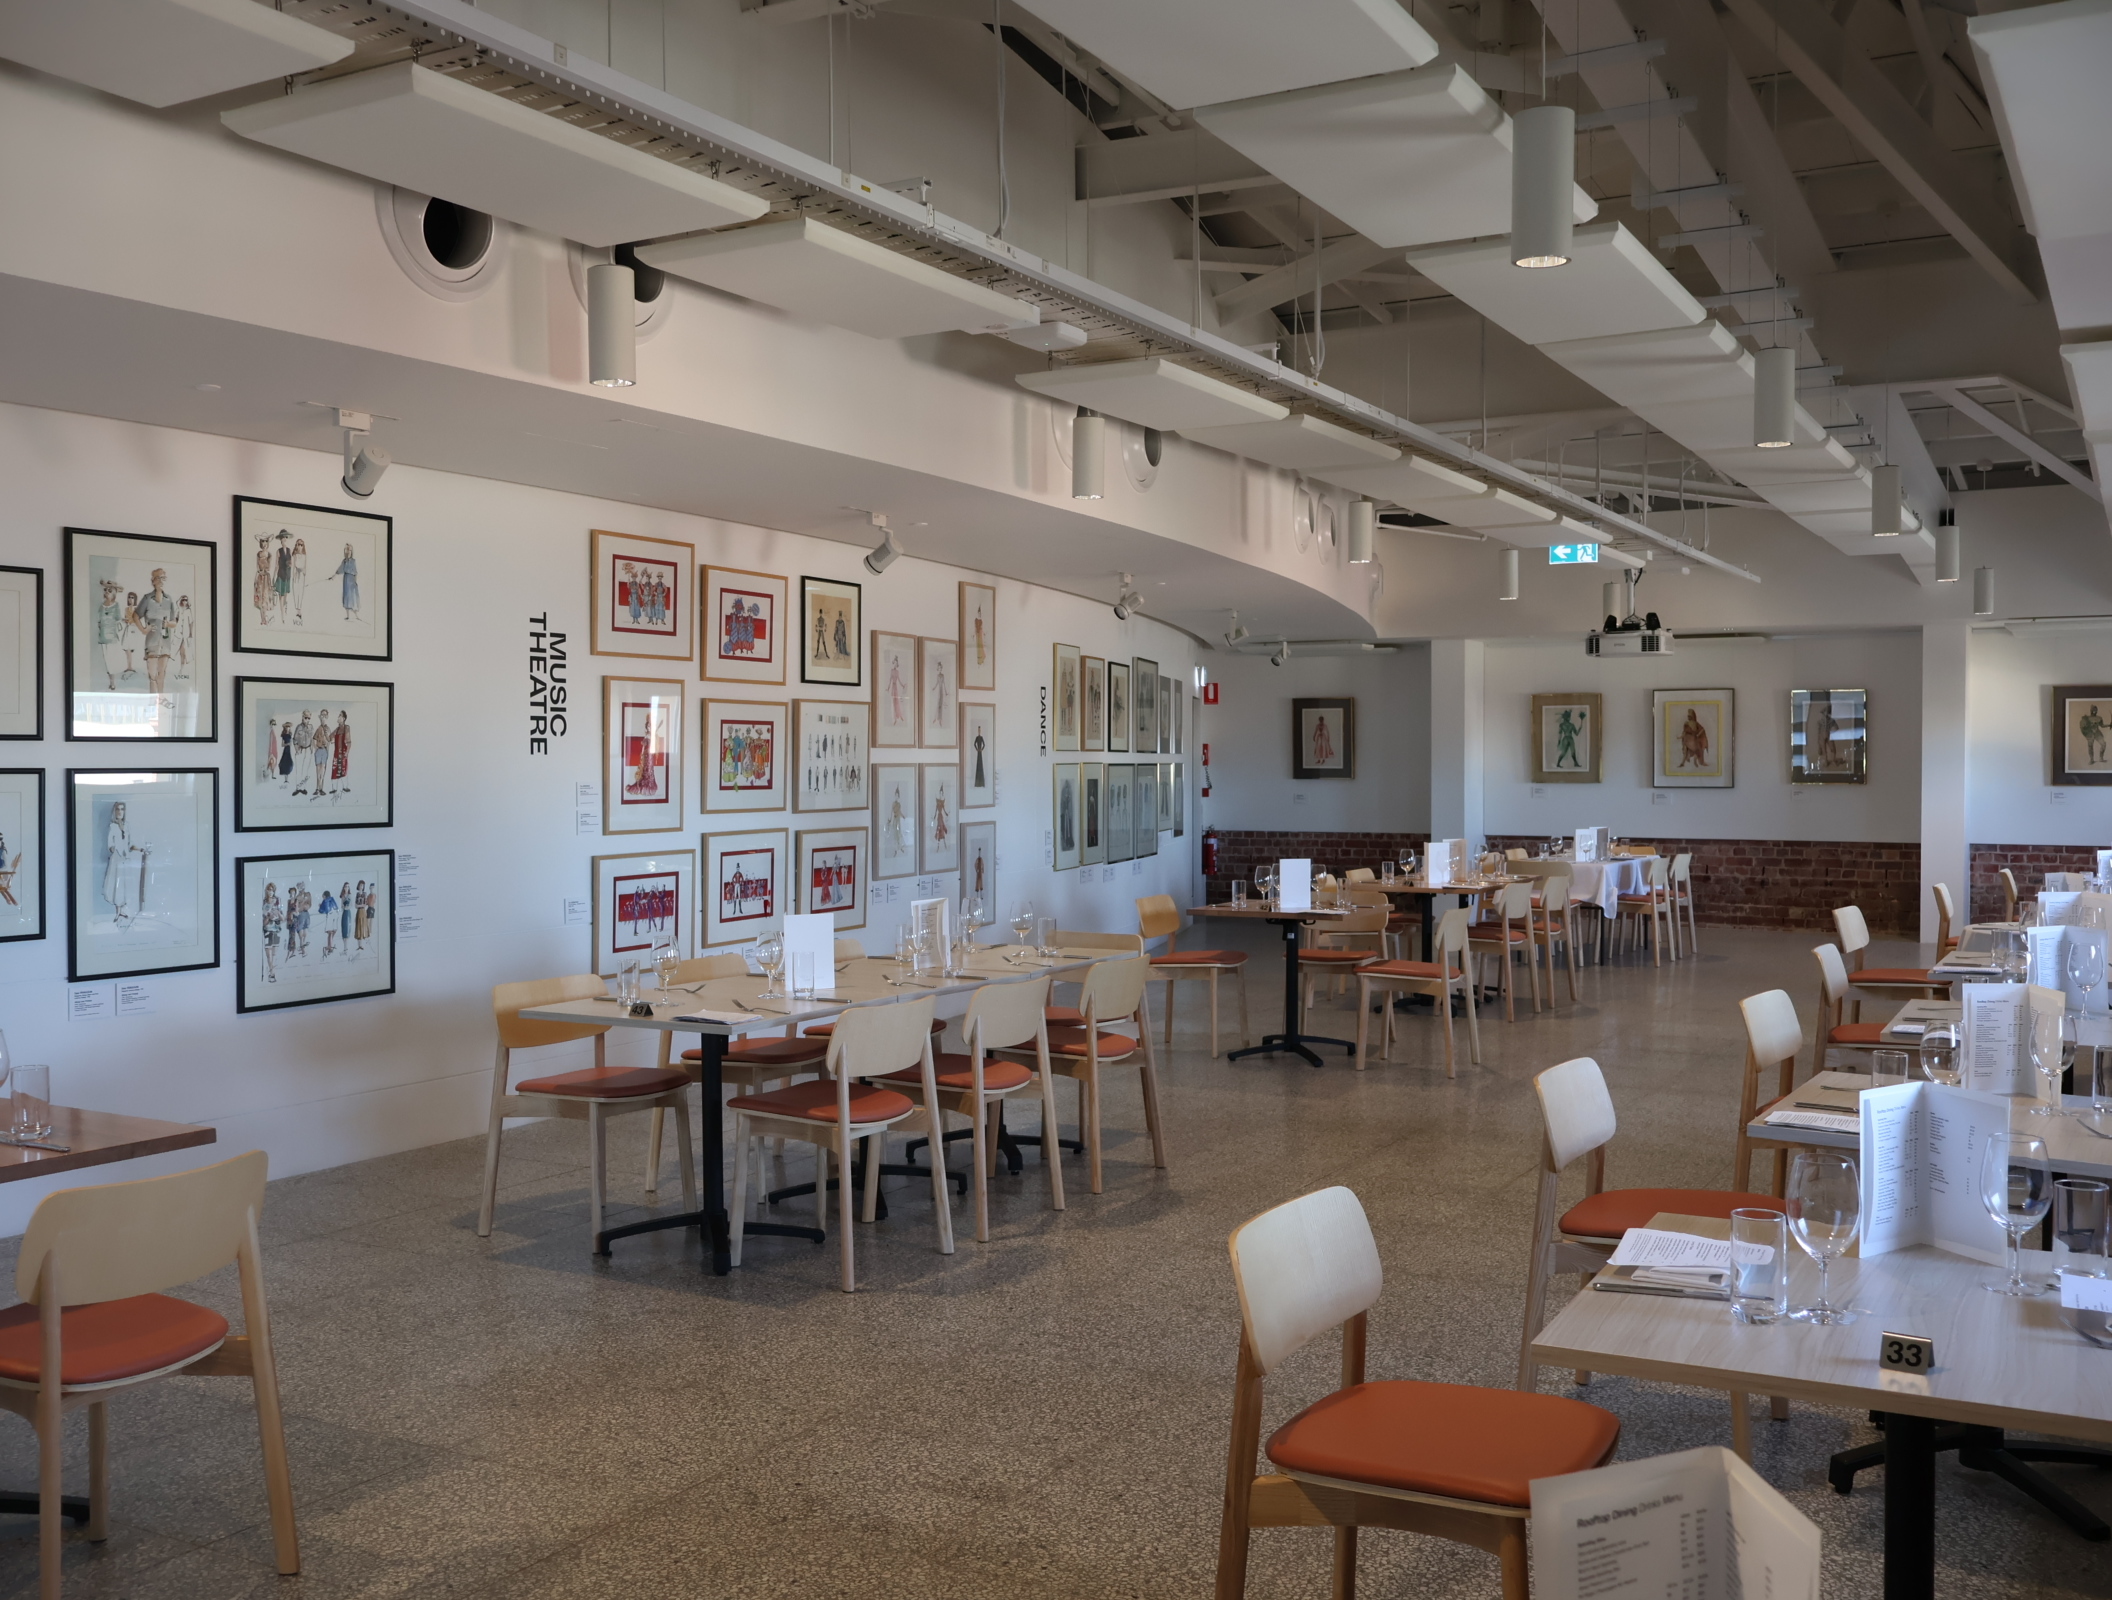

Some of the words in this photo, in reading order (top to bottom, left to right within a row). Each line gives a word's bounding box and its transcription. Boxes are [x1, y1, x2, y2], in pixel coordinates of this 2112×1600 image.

[529, 611, 548, 755] THEATRE
[549, 632, 567, 737] MUSIC
[632, 1005, 644, 1015] 43
[1887, 1341, 1922, 1367] 33
[1577, 1513, 1611, 1528] Rooftop
[1612, 1507, 1638, 1520] Dining
